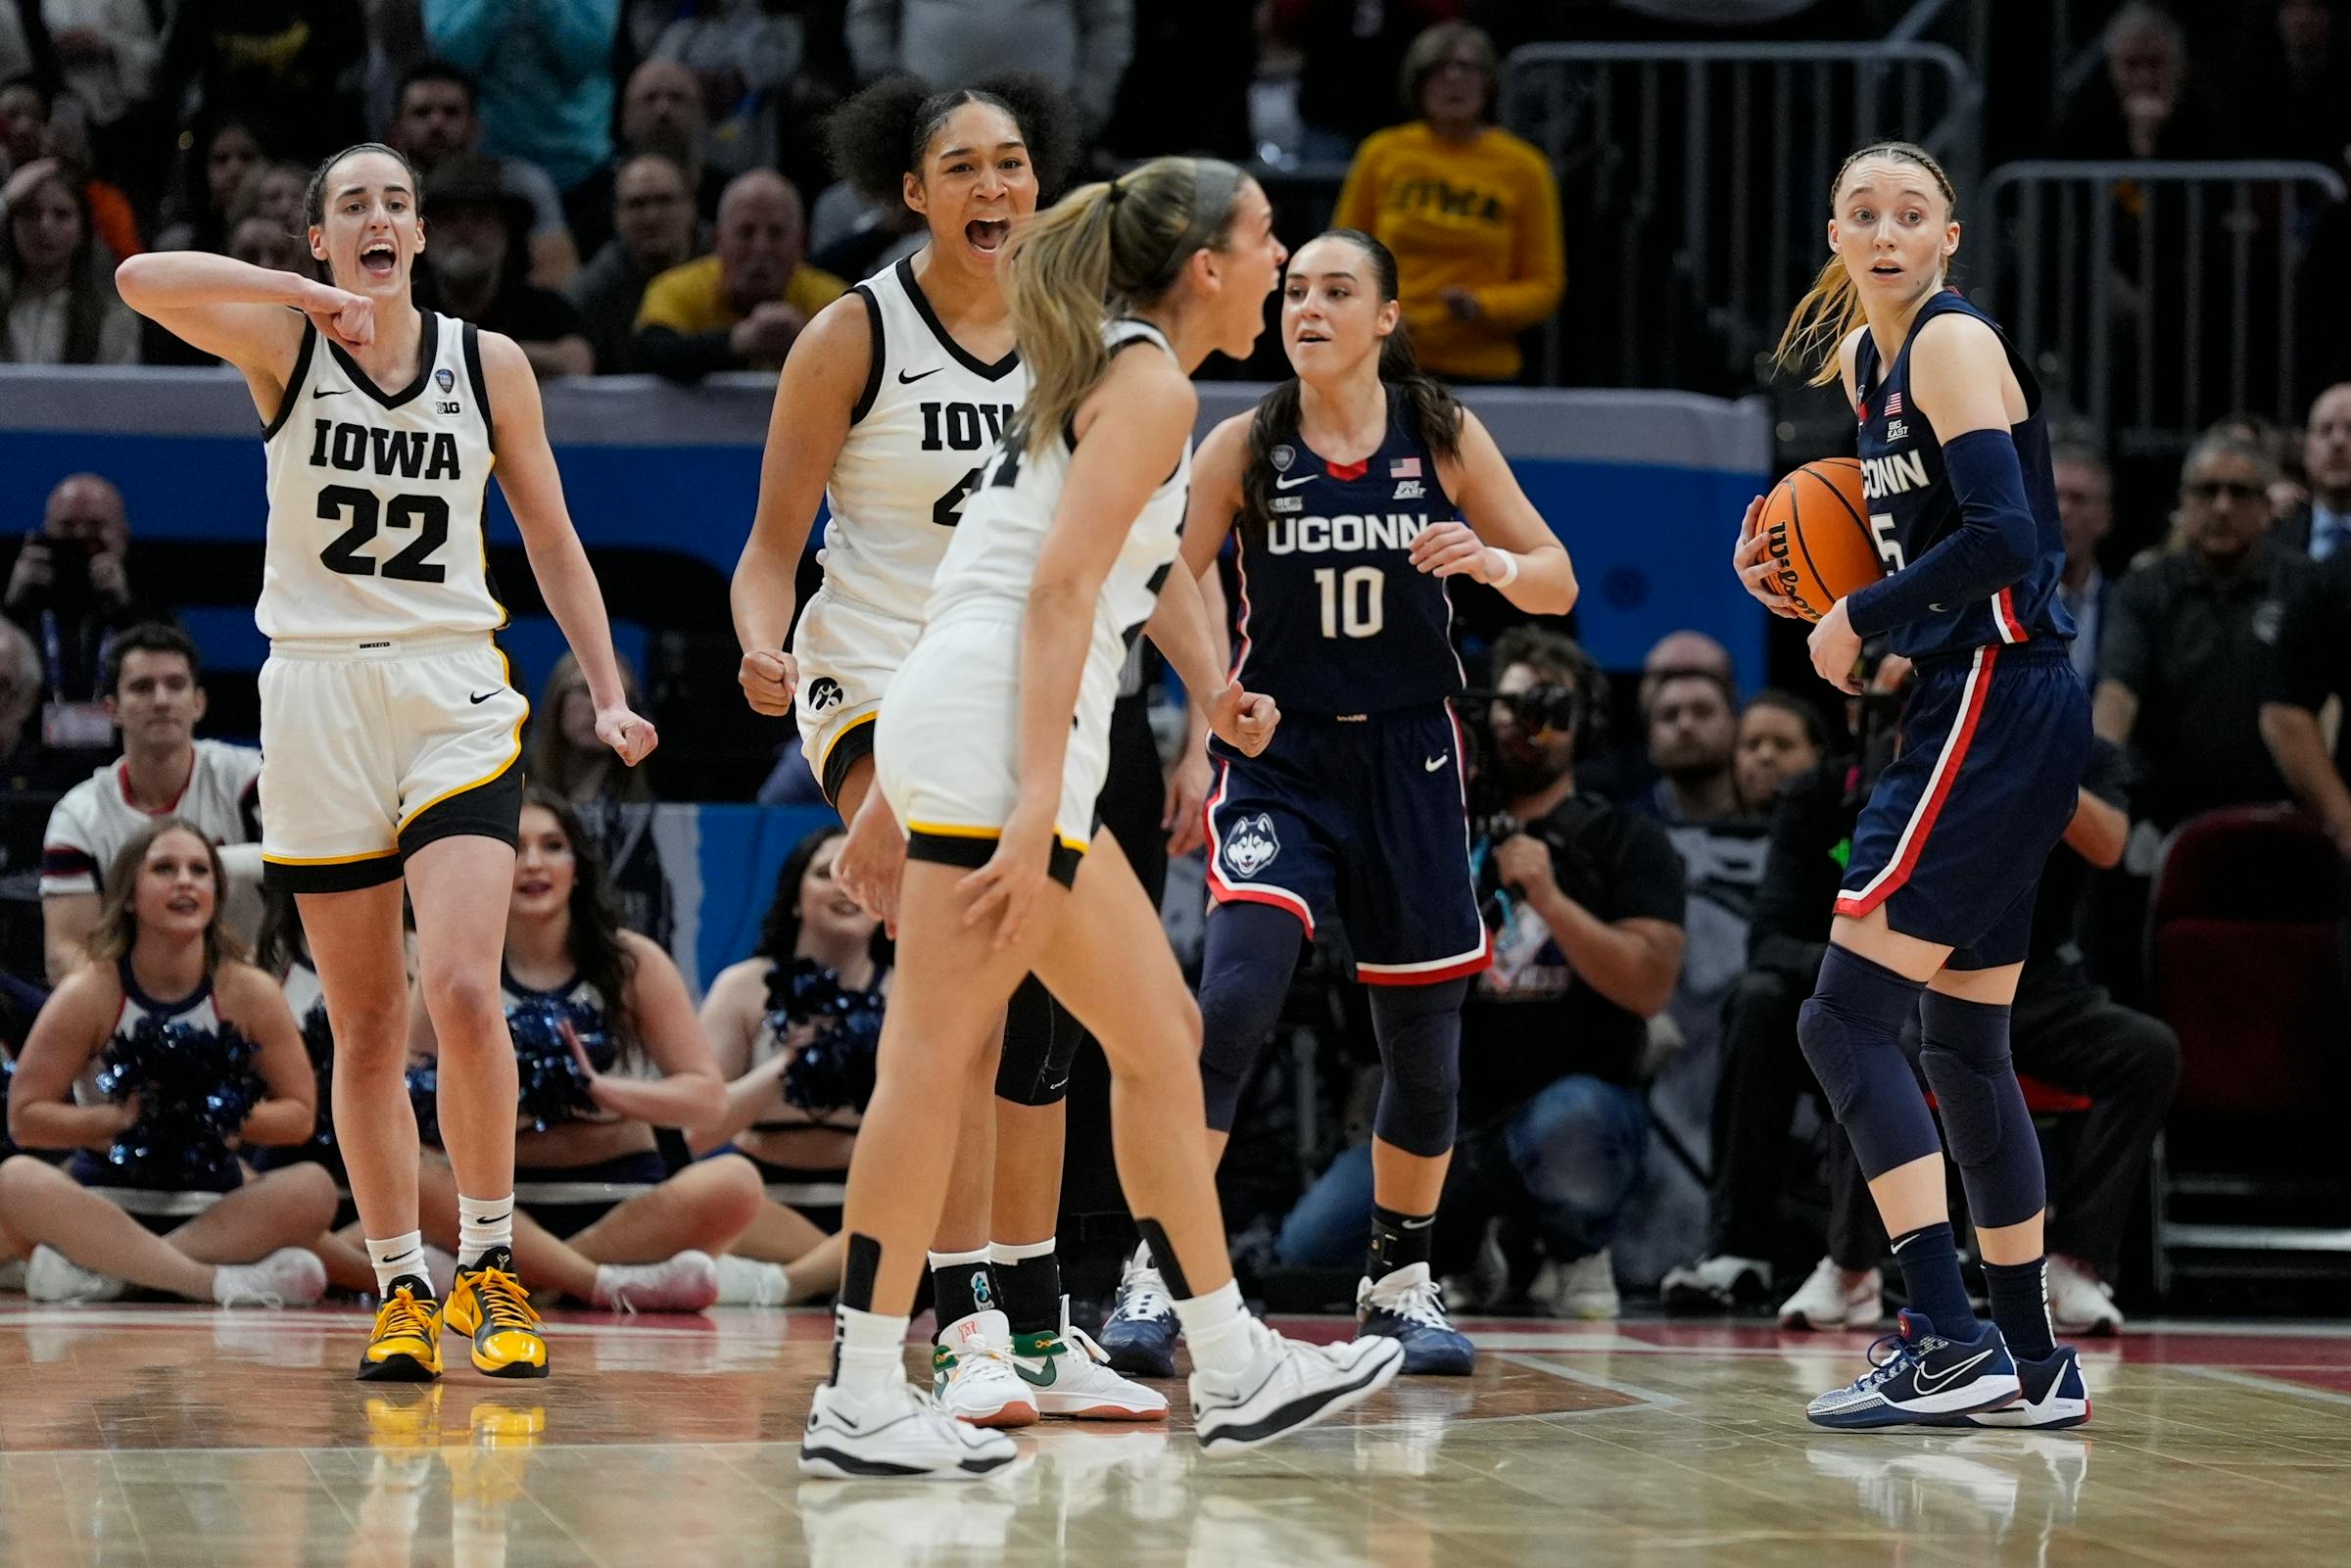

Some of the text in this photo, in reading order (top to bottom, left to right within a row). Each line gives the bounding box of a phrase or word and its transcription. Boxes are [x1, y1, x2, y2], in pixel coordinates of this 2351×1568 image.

[310, 418, 460, 480] IOWA
[920, 402, 1016, 451] IOW
[1887, 426, 1909, 439] EAST
[1860, 449, 1931, 500] CONN
[316, 484, 450, 584] 22
[1268, 513, 1428, 555] UCONN
[1869, 512, 1906, 578] 5
[1314, 565, 1385, 639] 10
